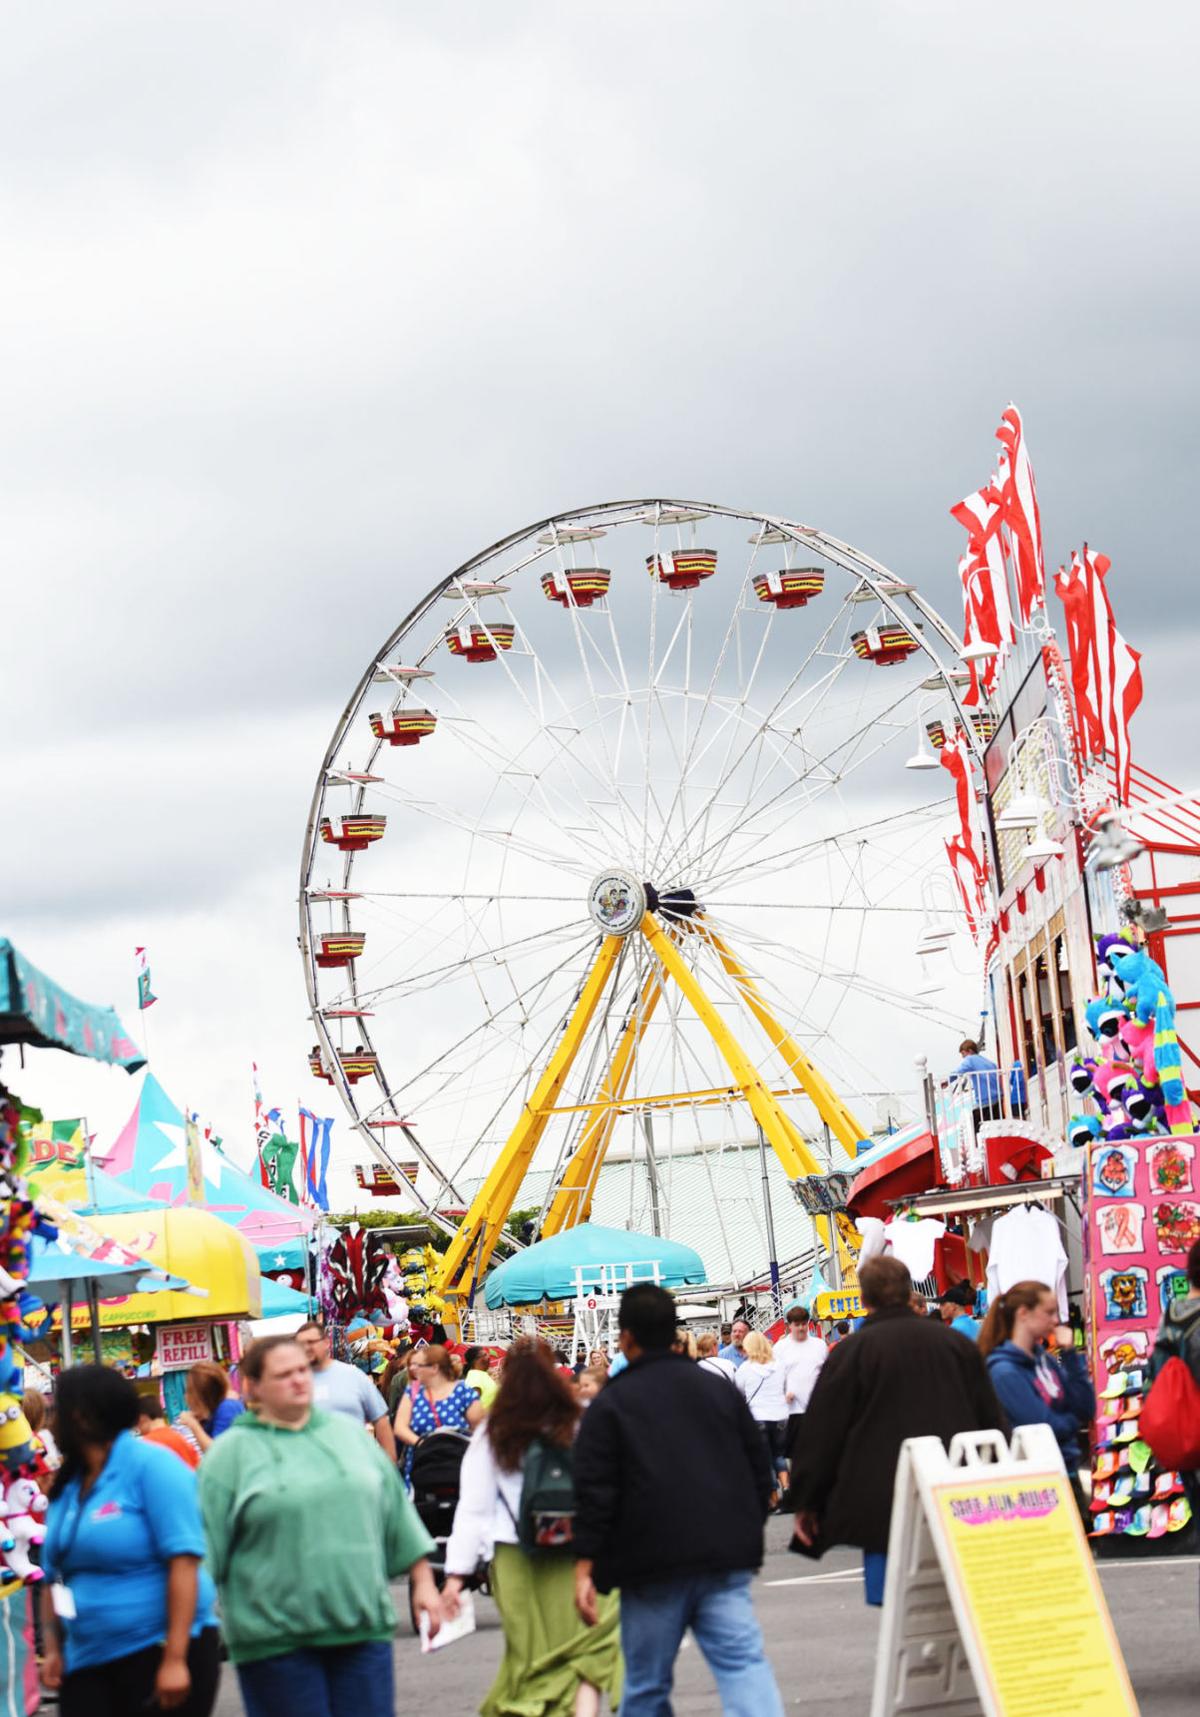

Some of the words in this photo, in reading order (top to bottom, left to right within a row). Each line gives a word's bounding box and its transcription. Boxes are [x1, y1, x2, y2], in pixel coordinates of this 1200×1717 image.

[31, 1139, 77, 1163] DE
[829, 1296, 865, 1313] ENTE
[163, 1329, 207, 1346] FREE
[164, 1345, 208, 1362] REFILL
